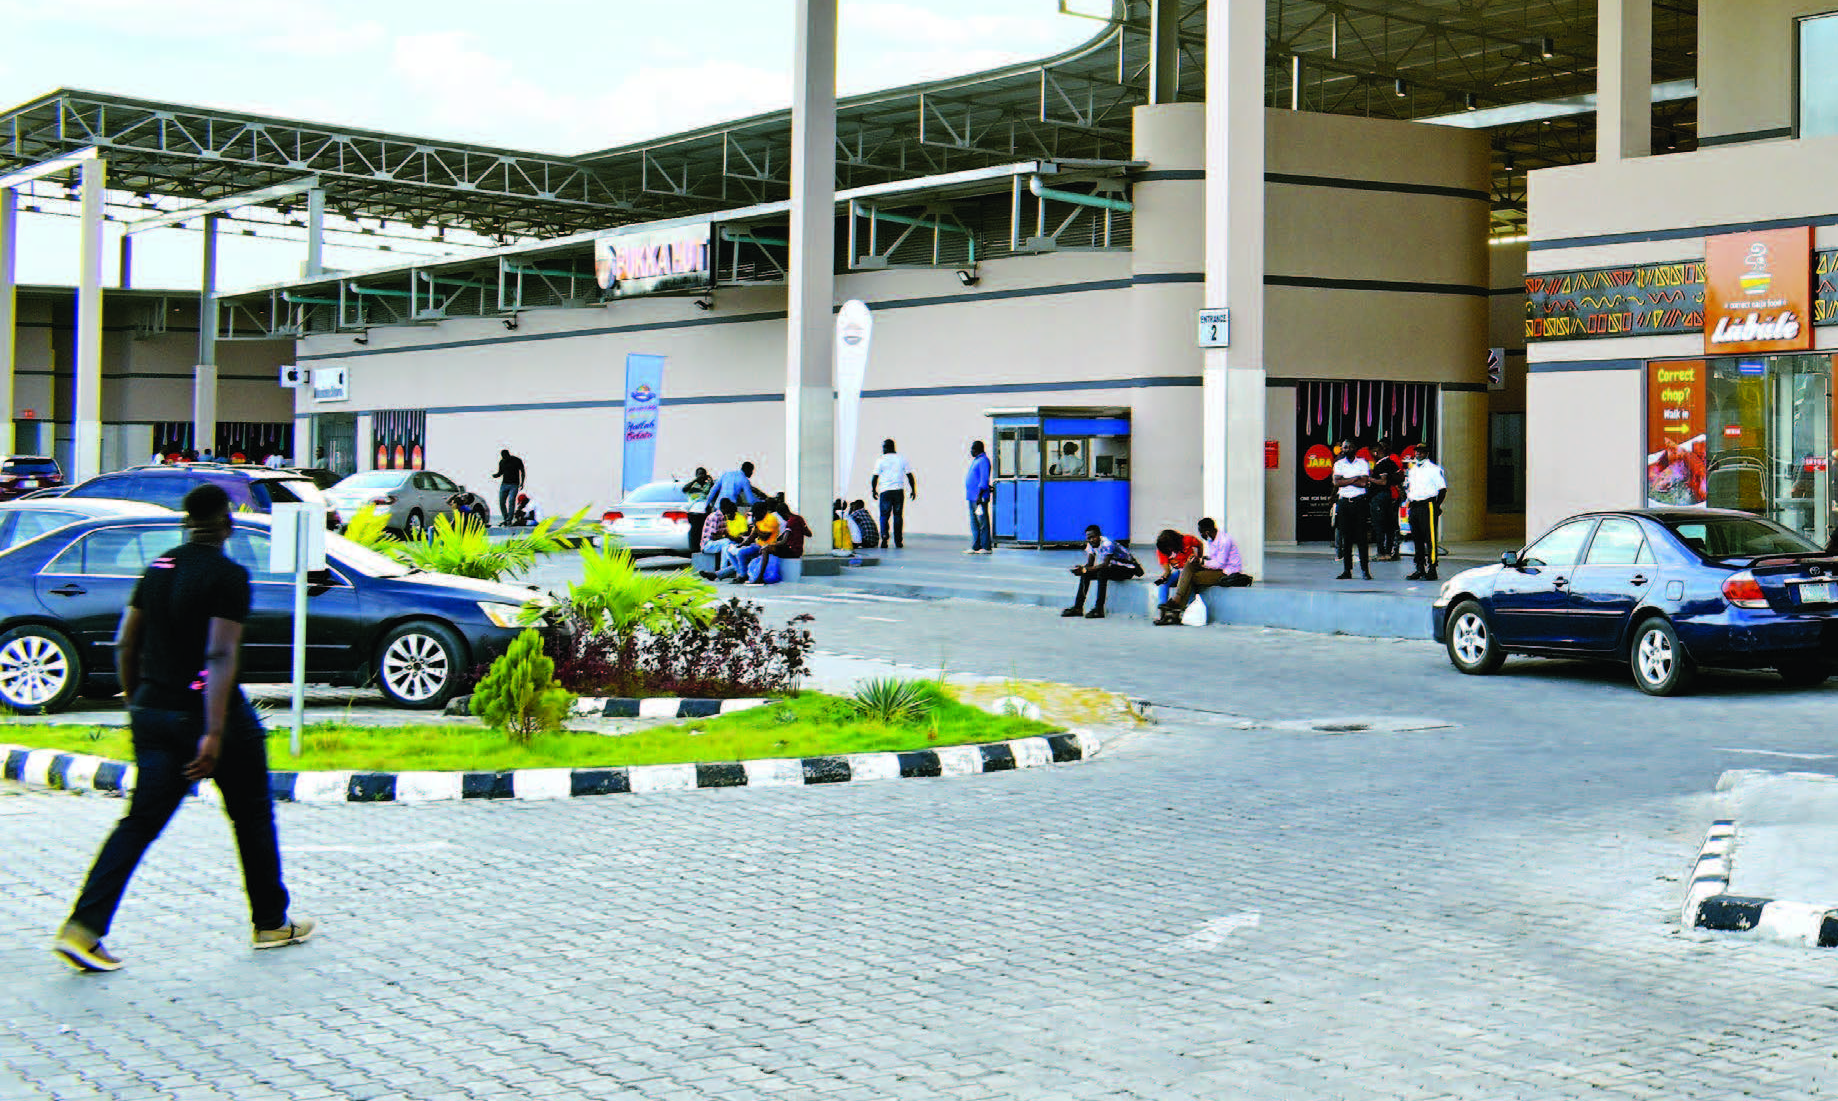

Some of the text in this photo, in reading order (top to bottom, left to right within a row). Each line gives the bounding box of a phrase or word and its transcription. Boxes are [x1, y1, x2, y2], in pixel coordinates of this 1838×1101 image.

[672, 239, 709, 276] HUT
[1200, 314, 1227, 323] ENTRANCE
[1211, 324, 1218, 341] 2
[1657, 367, 1696, 383] Correct
[1661, 387, 1691, 406] chop?
[1663, 408, 1690, 420] Walk in
[1307, 457, 1333, 468] JARA
